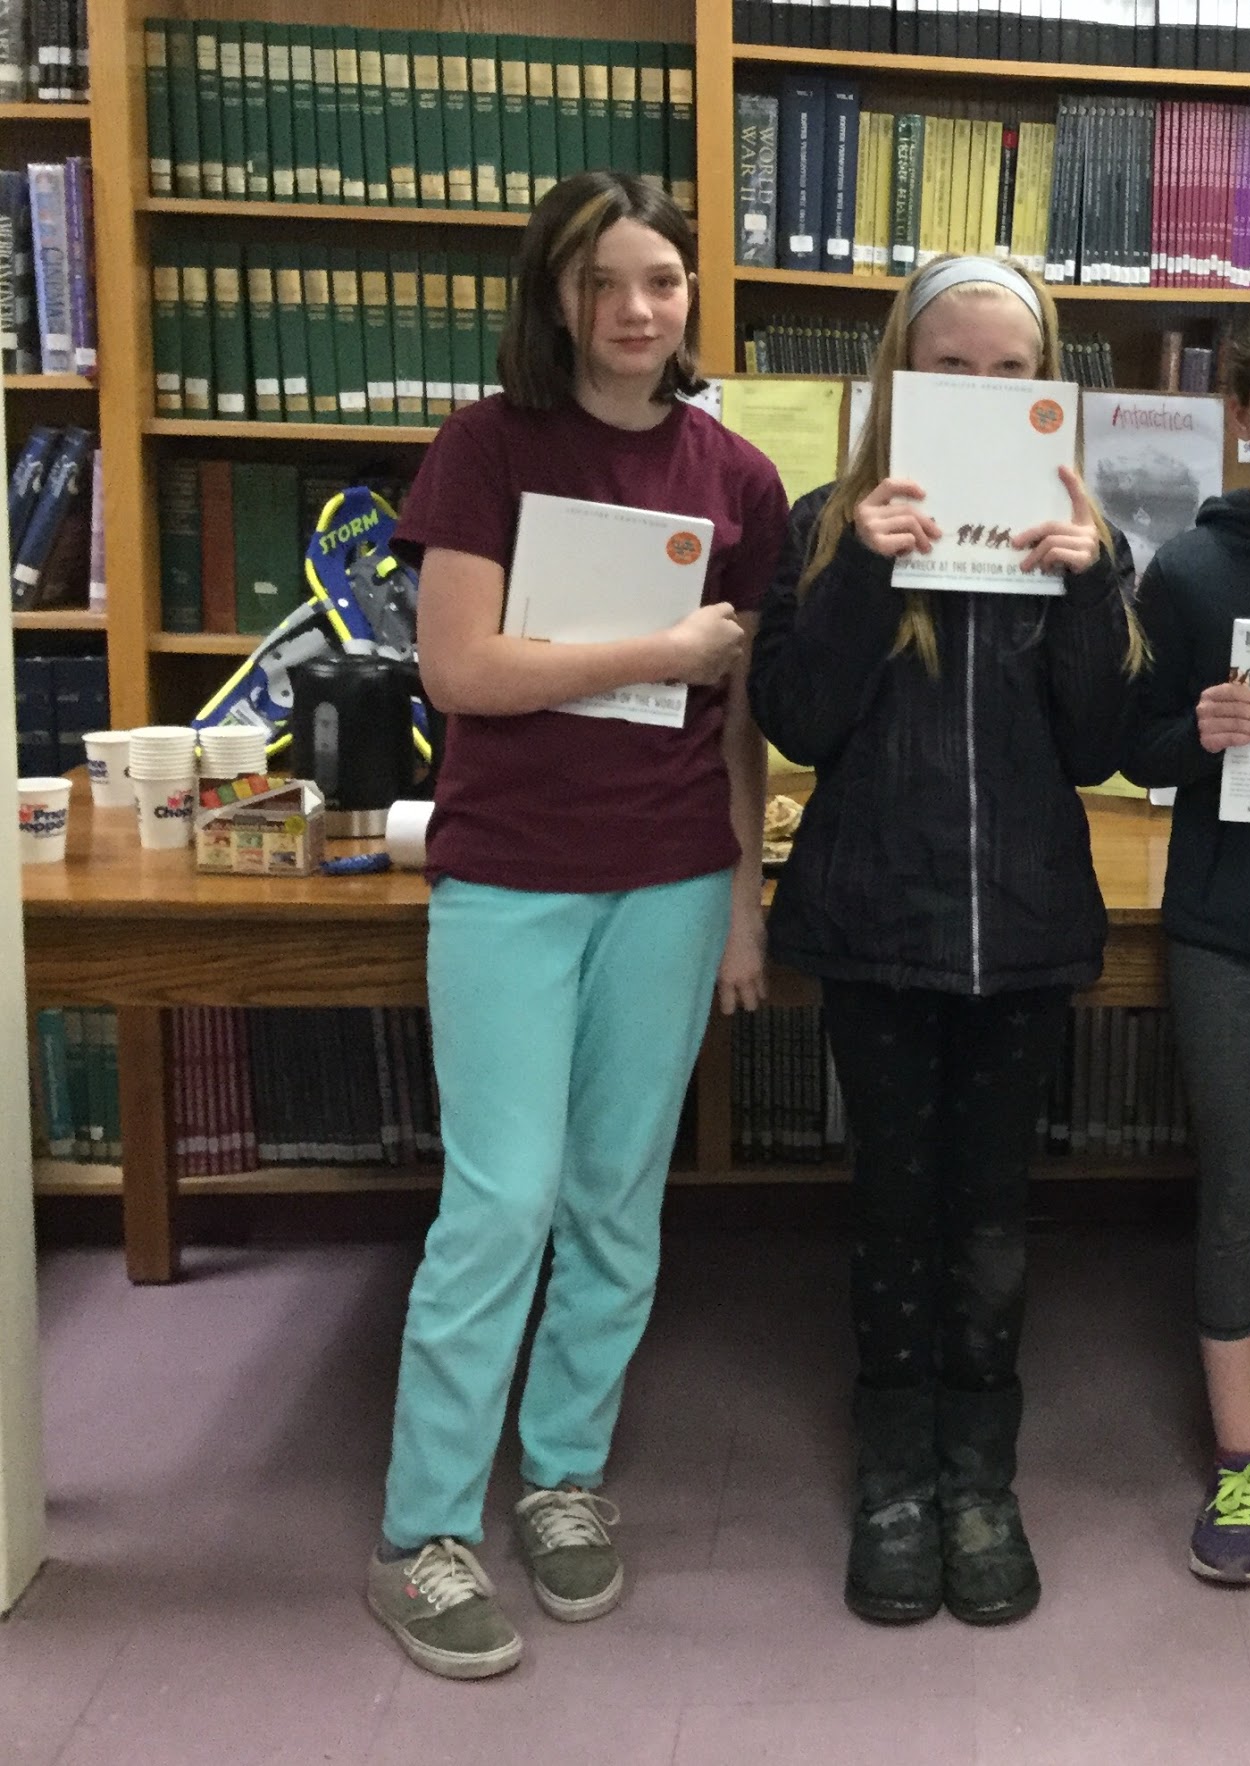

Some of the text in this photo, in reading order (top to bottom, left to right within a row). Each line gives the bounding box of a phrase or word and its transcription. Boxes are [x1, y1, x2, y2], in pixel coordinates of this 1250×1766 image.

[740, 125, 757, 202] WAR II
[759, 126, 775, 204] WORLD
[1111, 403, 1194, 431] Antarctica
[318, 508, 379, 555] STORM
[952, 561, 967, 573] THE
[971, 562, 1003, 574] BOTTOM
